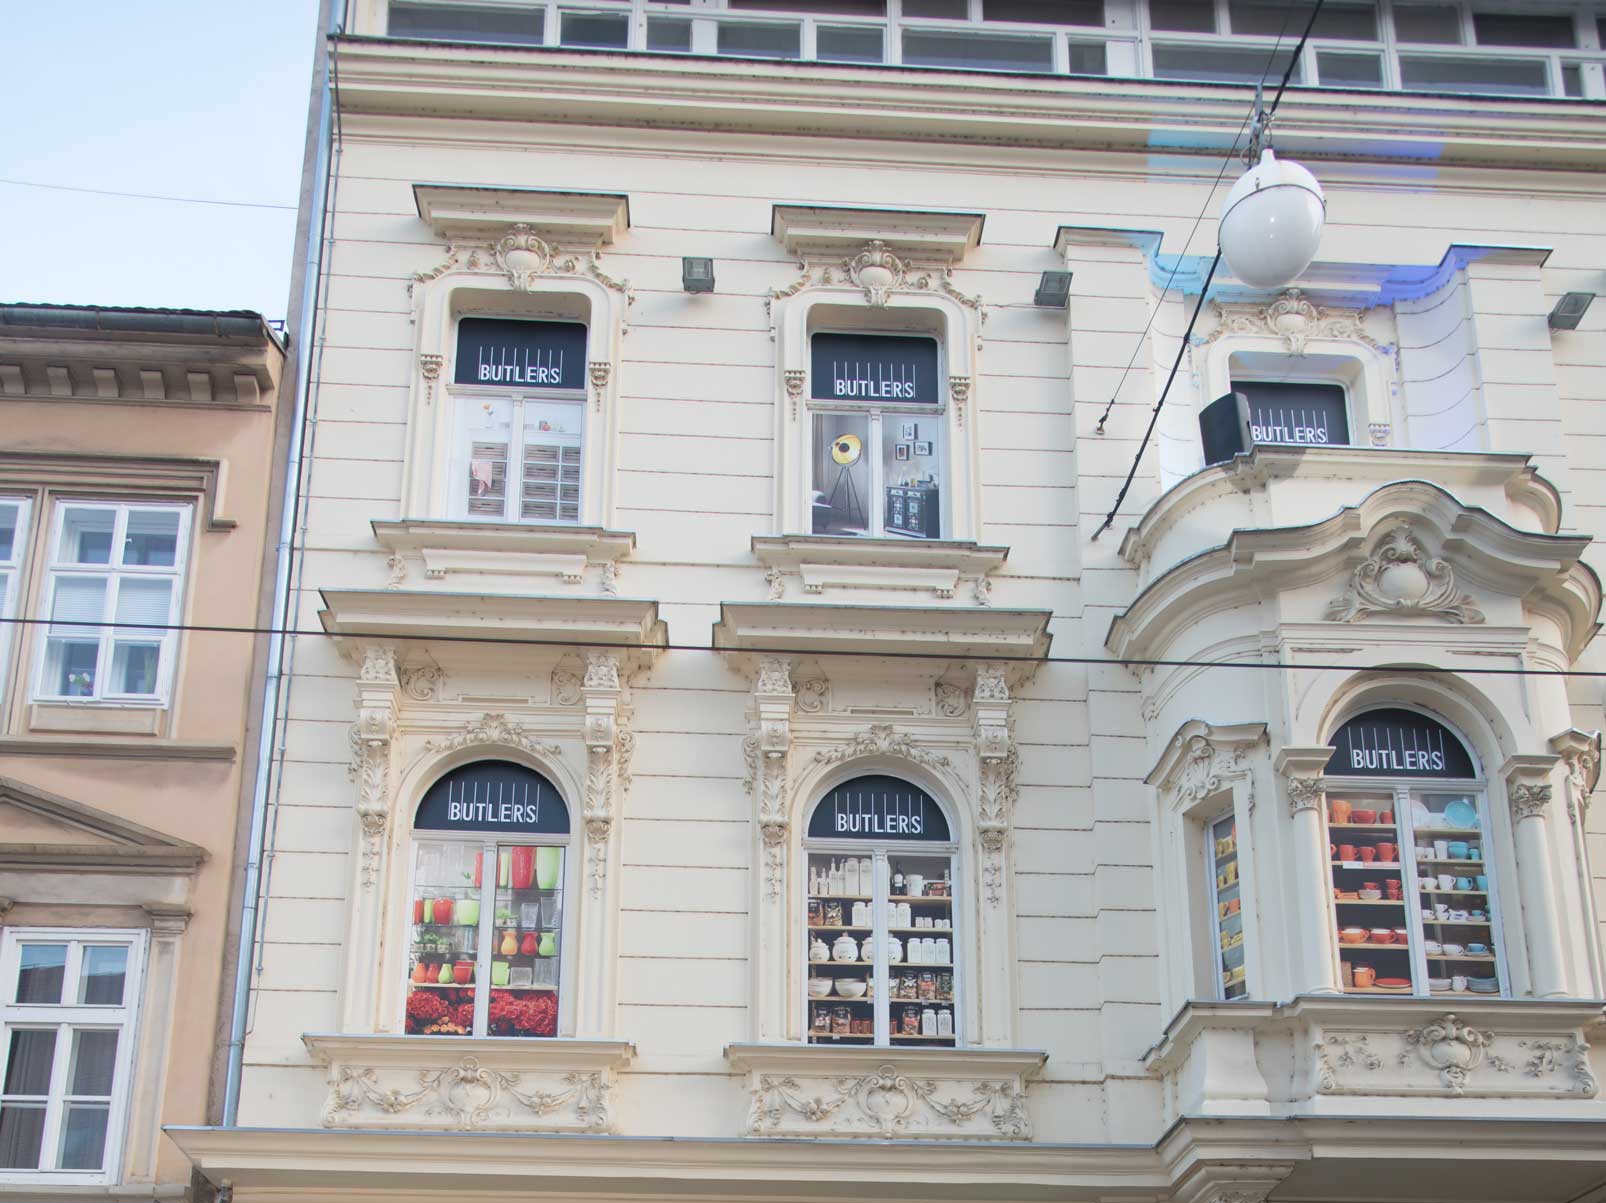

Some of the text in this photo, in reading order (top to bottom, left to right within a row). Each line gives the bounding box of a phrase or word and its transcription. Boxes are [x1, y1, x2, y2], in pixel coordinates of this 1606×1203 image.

[480, 364, 560, 384] BUTLERS
[835, 379, 914, 399] BUTLERS
[1252, 425, 1327, 443] BUTLERS
[1352, 749, 1444, 771] BUTLERS
[449, 802, 537, 824] BUTLERS
[837, 813, 922, 834] BUTLERS
